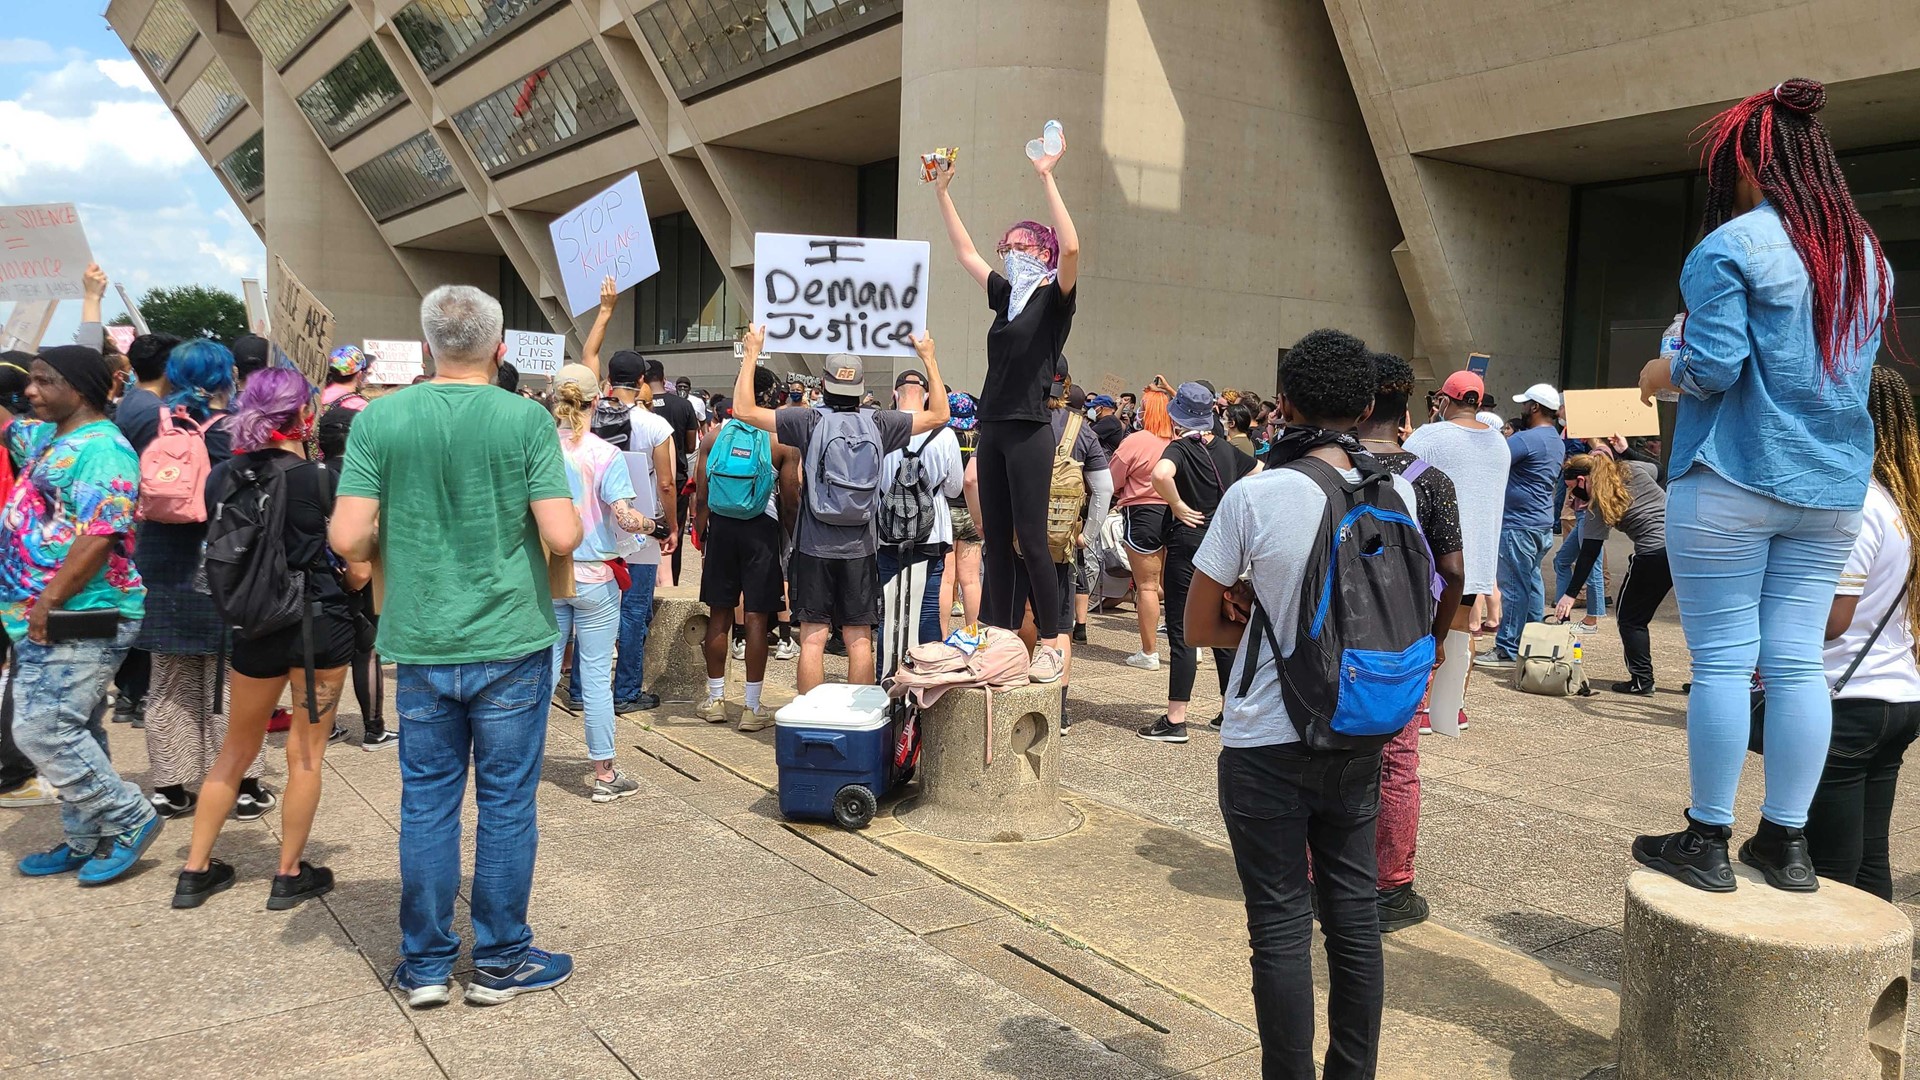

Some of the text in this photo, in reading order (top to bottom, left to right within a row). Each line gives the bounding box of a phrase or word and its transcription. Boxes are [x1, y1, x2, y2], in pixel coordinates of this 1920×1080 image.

[16, 207, 76, 229] SILENCE
[558, 190, 623, 264] STOP
[580, 224, 640, 279] KILLING
[804, 239, 866, 268] I
[765, 262, 922, 311] Demand
[303, 304, 328, 350] ARE
[516, 332, 555, 347] BLACK
[766, 311, 916, 351] Justice
[515, 358, 557, 371] MATTER
[518, 347, 554, 358] LIVES
